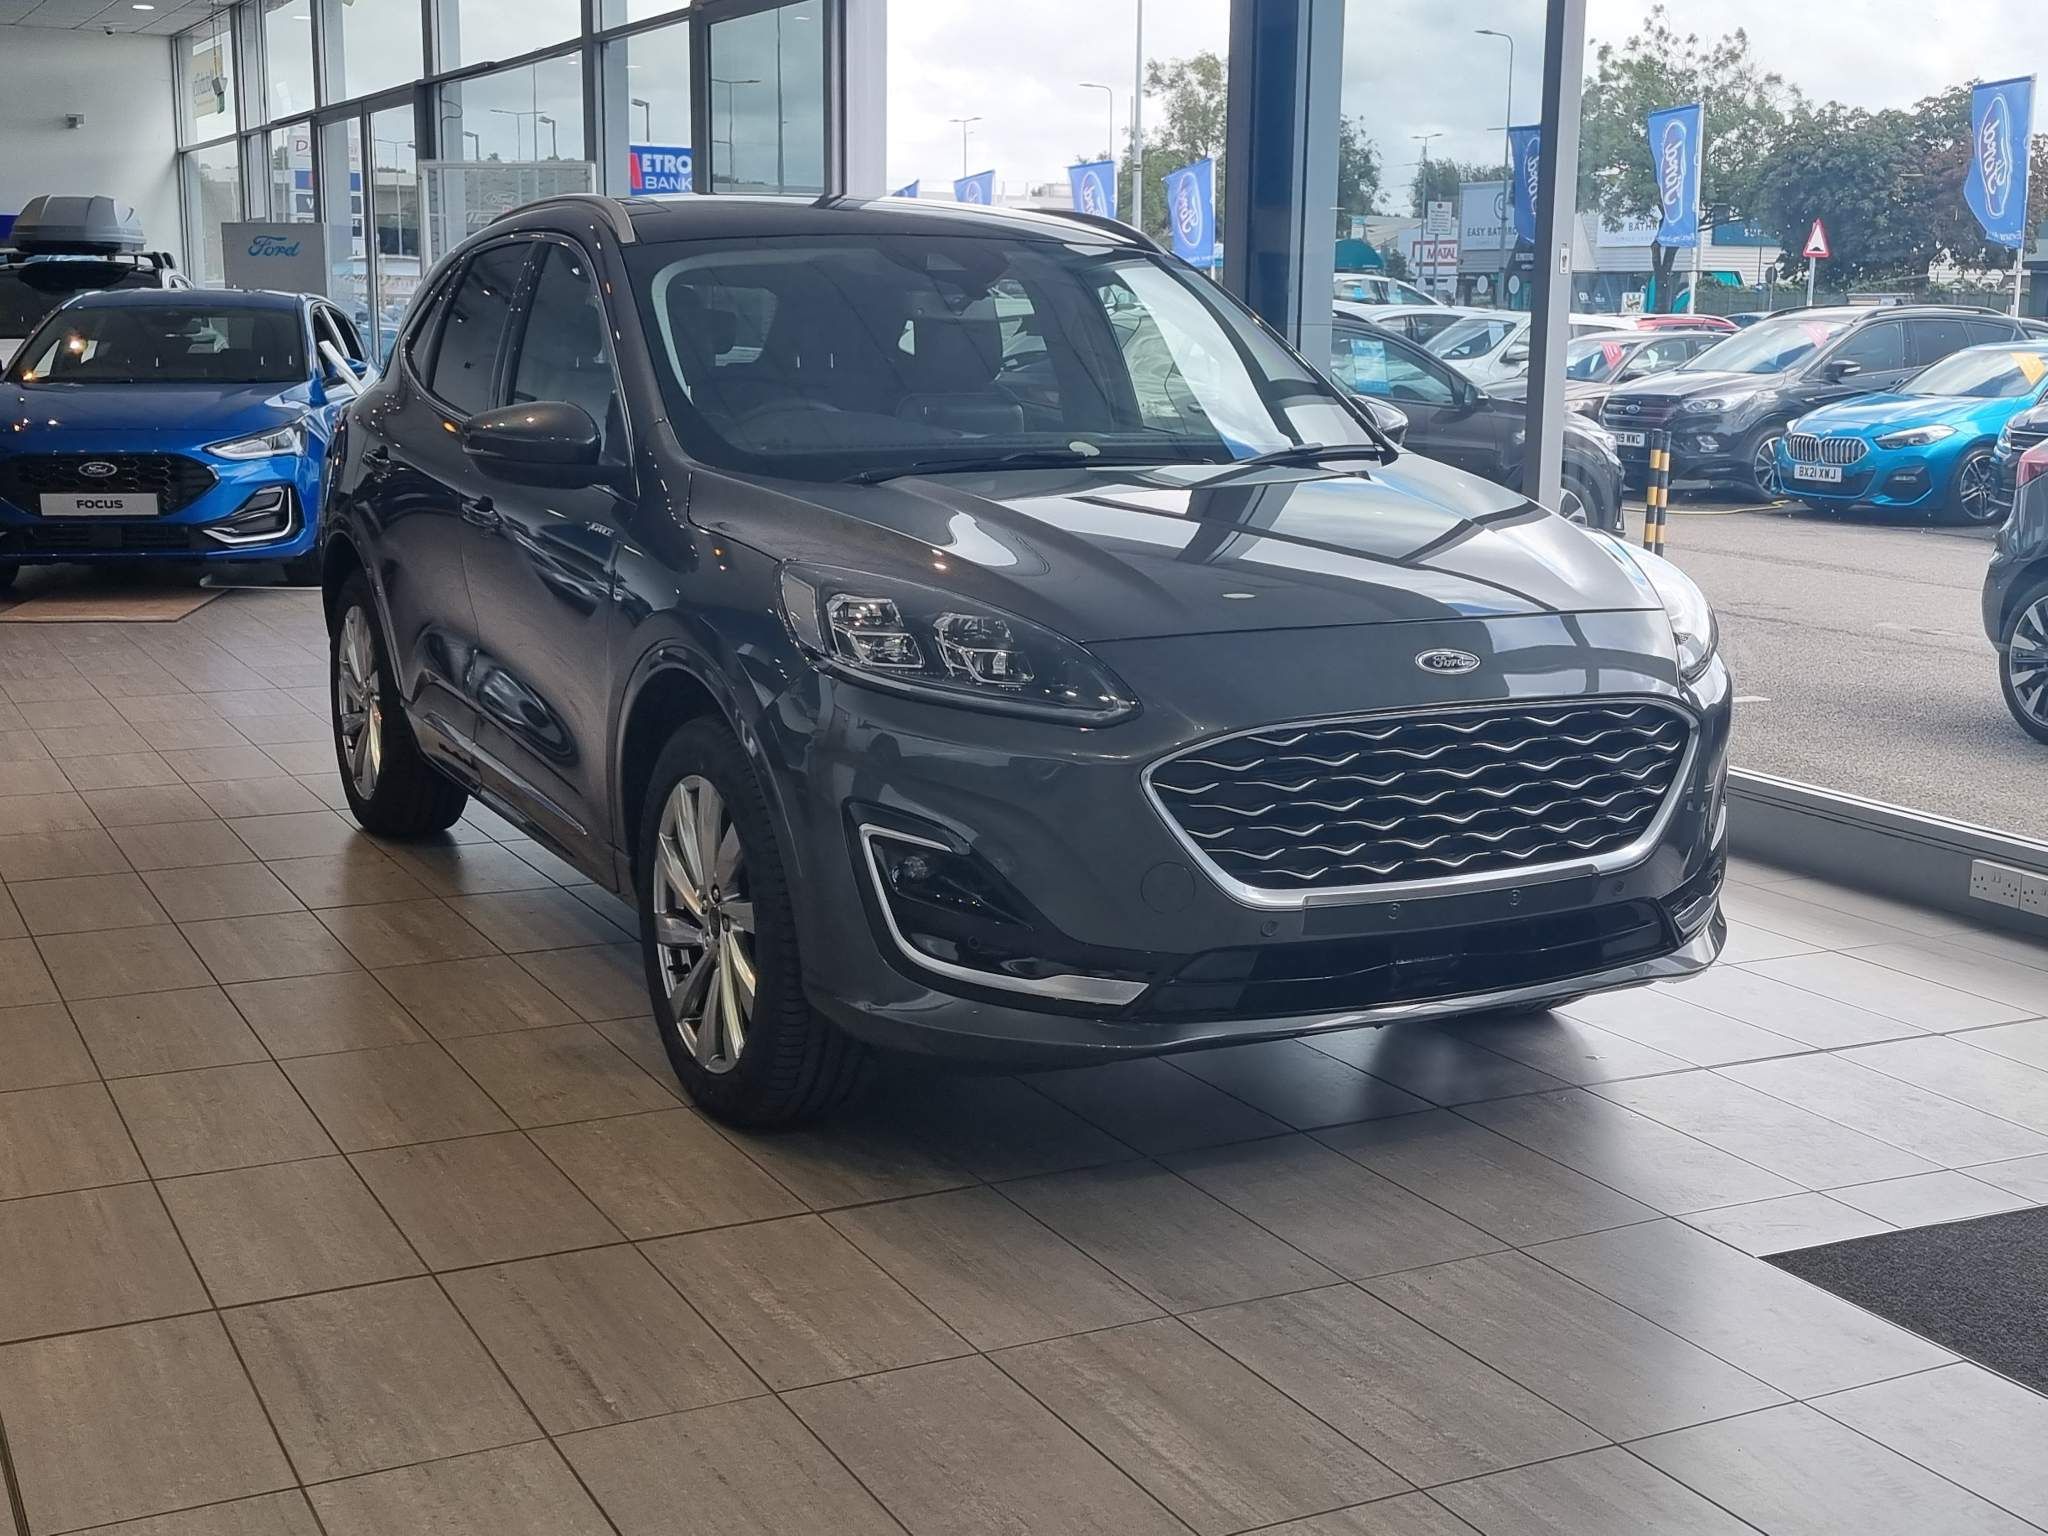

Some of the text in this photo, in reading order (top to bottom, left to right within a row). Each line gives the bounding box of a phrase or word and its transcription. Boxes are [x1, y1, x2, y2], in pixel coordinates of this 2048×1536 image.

[645, 176, 692, 190] BANK
[1467, 227, 1486, 237] EASY
[247, 235, 301, 257] Ford
[1427, 247, 1457, 259] MATAL
[76, 499, 124, 509] FOCUS
[1433, 654, 1466, 668] Ford
